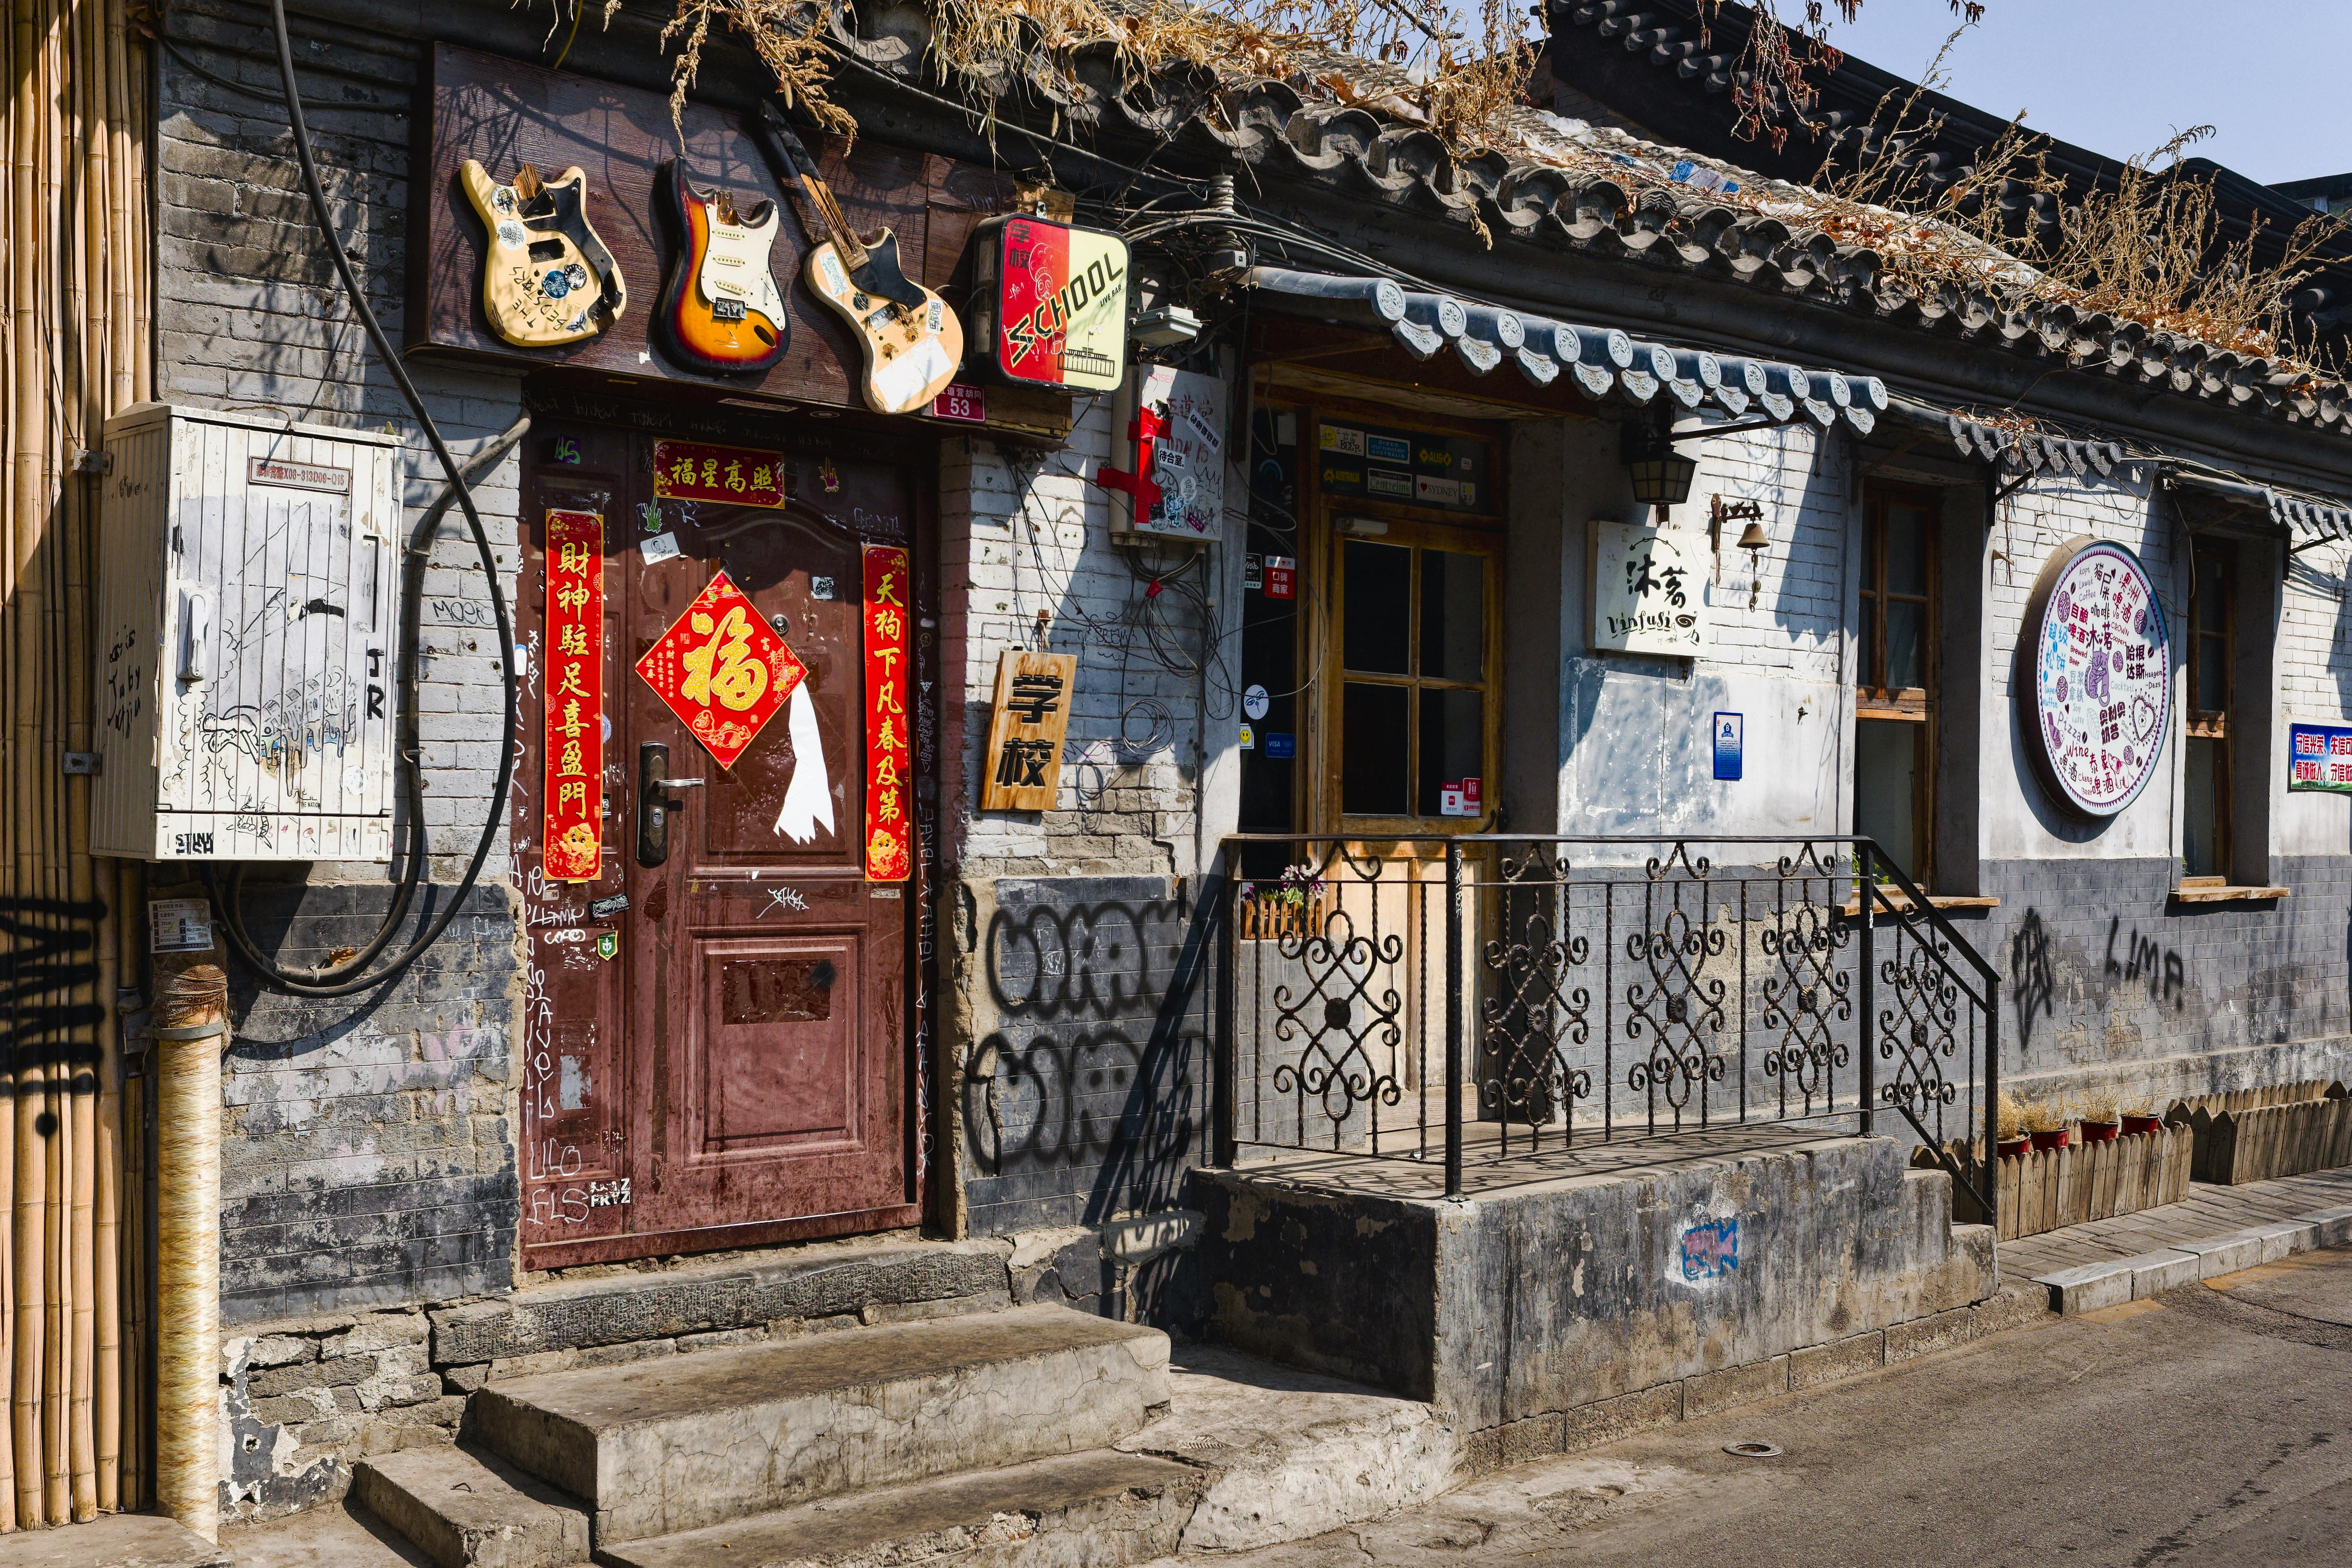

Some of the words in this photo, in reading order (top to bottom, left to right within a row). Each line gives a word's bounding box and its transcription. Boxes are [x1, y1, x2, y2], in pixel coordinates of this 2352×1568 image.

[1009, 222, 1031, 270] 学校
[1100, 294, 1111, 308] LIVE
[1111, 285, 1122, 298] BAR
[1008, 252, 1123, 368] SCHOOL
[940, 386, 982, 400] 道营胡同
[950, 397, 970, 416] 53
[1340, 440, 1361, 453] BEER
[1372, 450, 1405, 459] AUSTRALIA
[1429, 451, 1443, 464] AUS
[670, 457, 776, 493] 福星高照
[1335, 470, 1360, 483] AUSTRALIA
[1370, 476, 1411, 494] Centrelink
[1428, 486, 1458, 497] SYDNEY
[1273, 571, 1288, 582] 口碑
[2079, 577, 2093, 589] Luwak
[1273, 583, 1288, 595] 商家
[2079, 589, 2096, 602] Coffee
[2119, 572, 2141, 605] 澳洲
[2071, 602, 2089, 625] 自酿
[2091, 602, 2110, 620] 咖啡
[2112, 591, 2133, 624] 啤酒
[2113, 610, 2119, 619] VB
[2048, 620, 2068, 646] 超级
[2068, 622, 2087, 644] 啤酒
[2111, 621, 2130, 637] CROWN
[2110, 632, 2128, 647] Coopers
[681, 606, 768, 711] 福
[2045, 645, 2066, 674] 松饼
[2070, 644, 2088, 658] Brewed
[2126, 644, 2145, 661] 哈根
[2069, 656, 2080, 667] Beer
[2069, 670, 2084, 685] 豆浆
[2126, 663, 2145, 680] 达斯
[2144, 670, 2163, 679] Haagen
[555, 541, 592, 820] 財神駐足喜盈門
[2044, 684, 2057, 694] Super
[2110, 680, 2134, 693] Cocktail
[2145, 681, 2161, 690] -Dazs
[873, 573, 905, 826] 天狗下凡春及第
[2042, 697, 2058, 709] Muffin
[2068, 686, 2084, 703] 拿铁
[2072, 704, 2081, 713] Soy
[2099, 701, 2126, 727] 奥利奥
[994, 674, 1064, 788] 学校
[2057, 711, 2081, 742] Pizza
[2101, 722, 2119, 745] 奶昔
[2066, 740, 2089, 757] Wine
[2059, 754, 2077, 782] 啤酒
[2078, 773, 2092, 785] Chang
[2092, 772, 2114, 797] 啤酒
[2081, 787, 2093, 795] Beer
[175, 833, 213, 844] STINK
